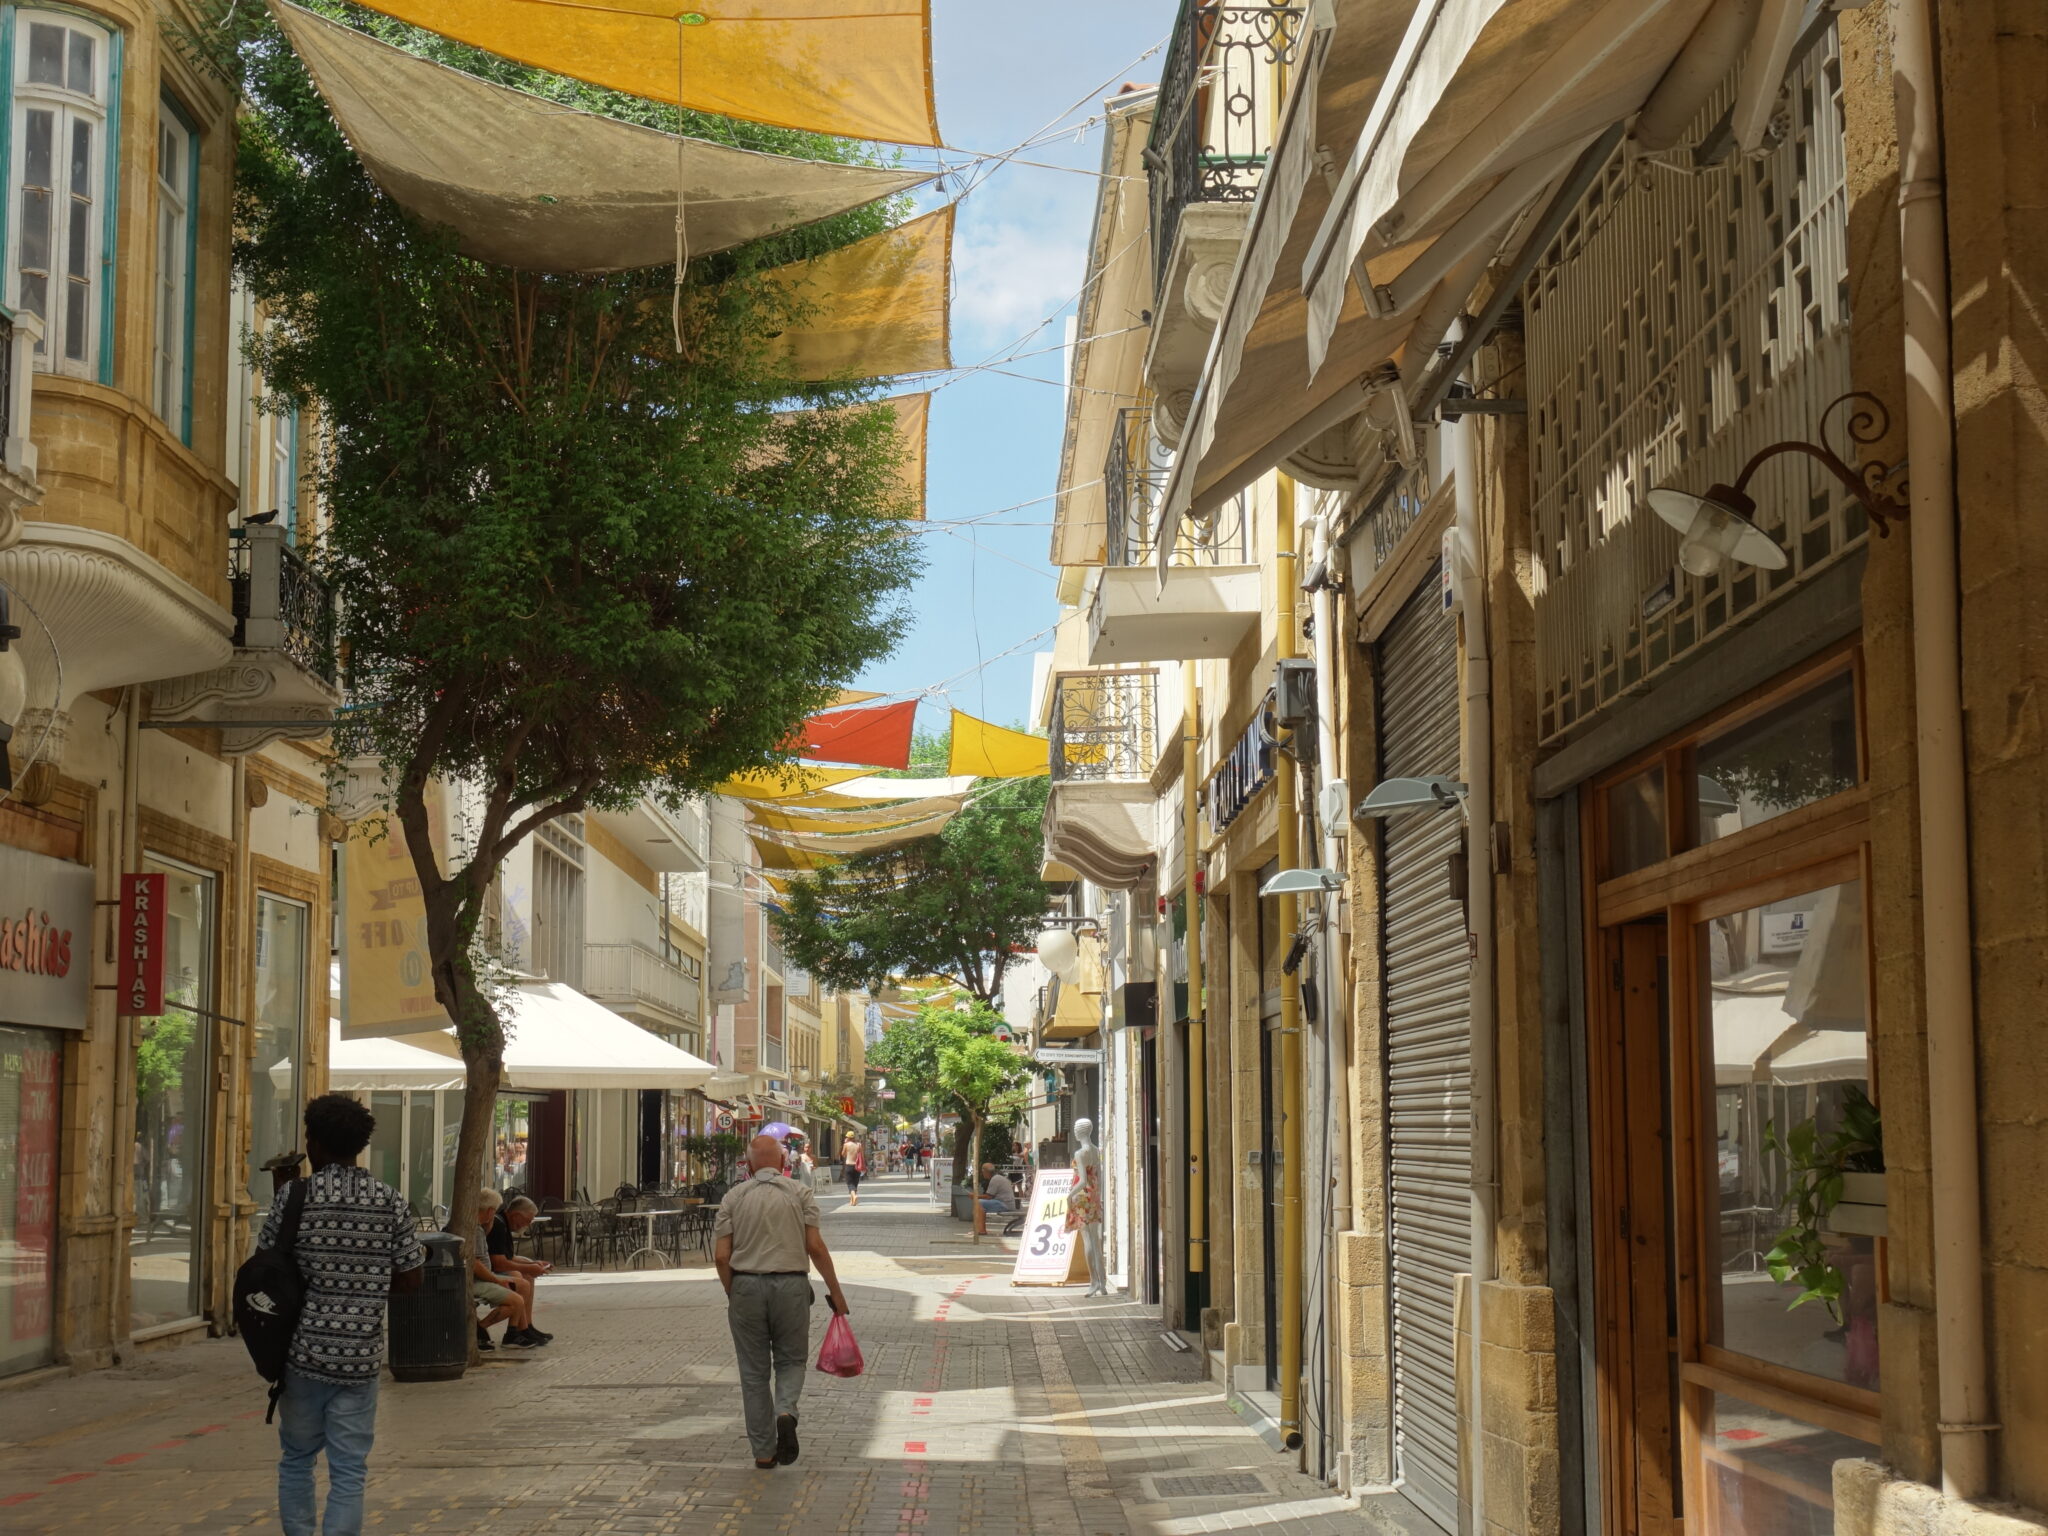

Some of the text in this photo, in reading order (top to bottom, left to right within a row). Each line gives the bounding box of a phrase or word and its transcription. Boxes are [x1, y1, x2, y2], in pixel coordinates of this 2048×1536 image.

[1209, 741, 1241, 833] BEAUTY
[132, 879, 149, 1009] KRASHIAS
[720, 1116, 731, 1126] 15
[1043, 1199, 1065, 1220] ALL
